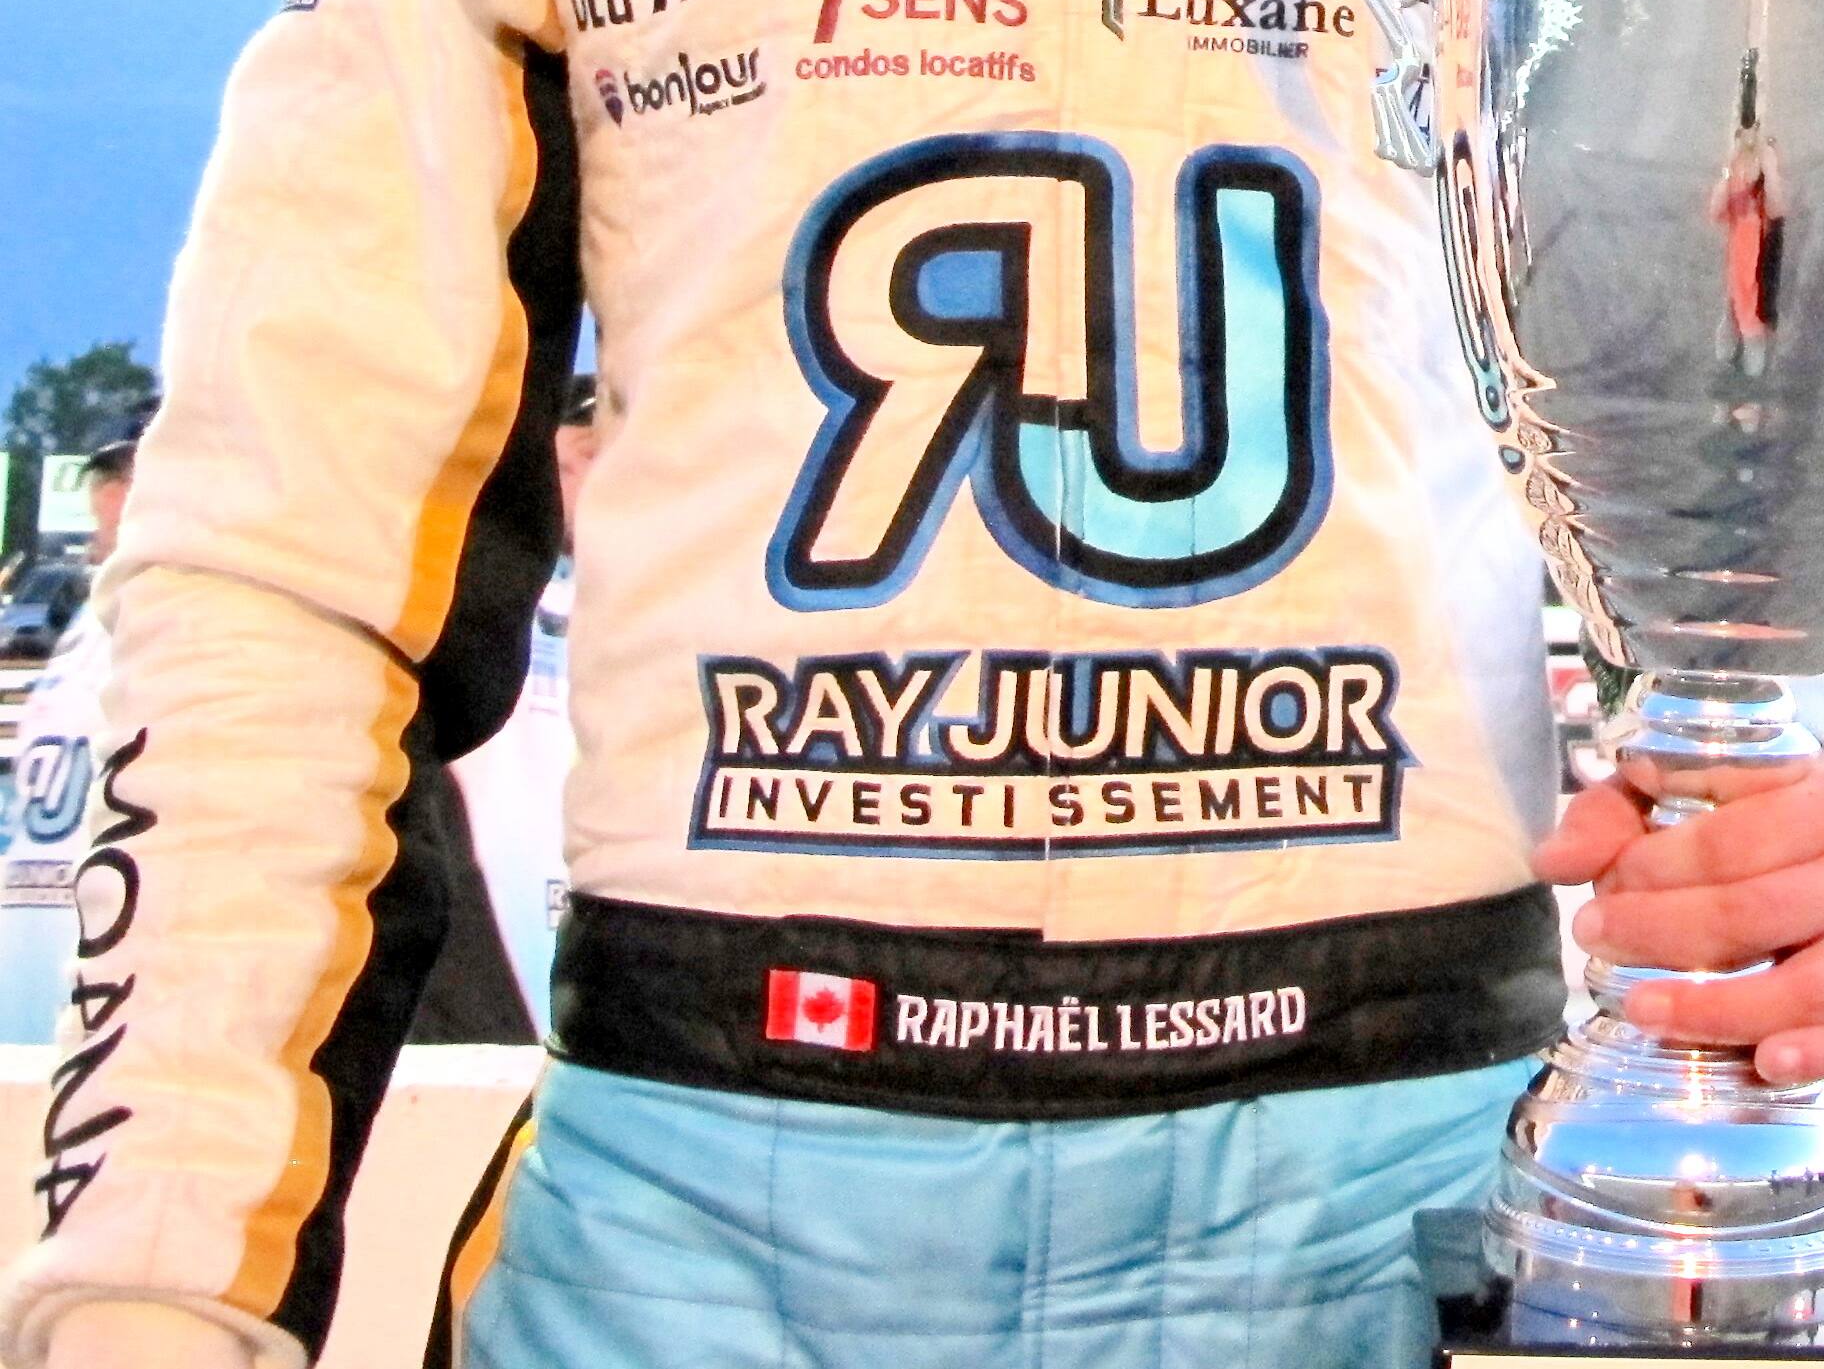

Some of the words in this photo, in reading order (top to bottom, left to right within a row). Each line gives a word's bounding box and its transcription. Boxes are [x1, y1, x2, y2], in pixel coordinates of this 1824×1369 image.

[795, 46, 910, 83] condos
[920, 48, 1036, 84] locatifs
[1187, 35, 1310, 61] IMMOBILIER
[623, 47, 761, 116] bonjour
[712, 666, 937, 760] RAY
[944, 662, 1391, 763] JUNIOR
[715, 772, 1376, 829] INVESTISSEMENT
[895, 993, 1109, 1053] RAPHAËL
[1116, 985, 1307, 1052] LESSARD
